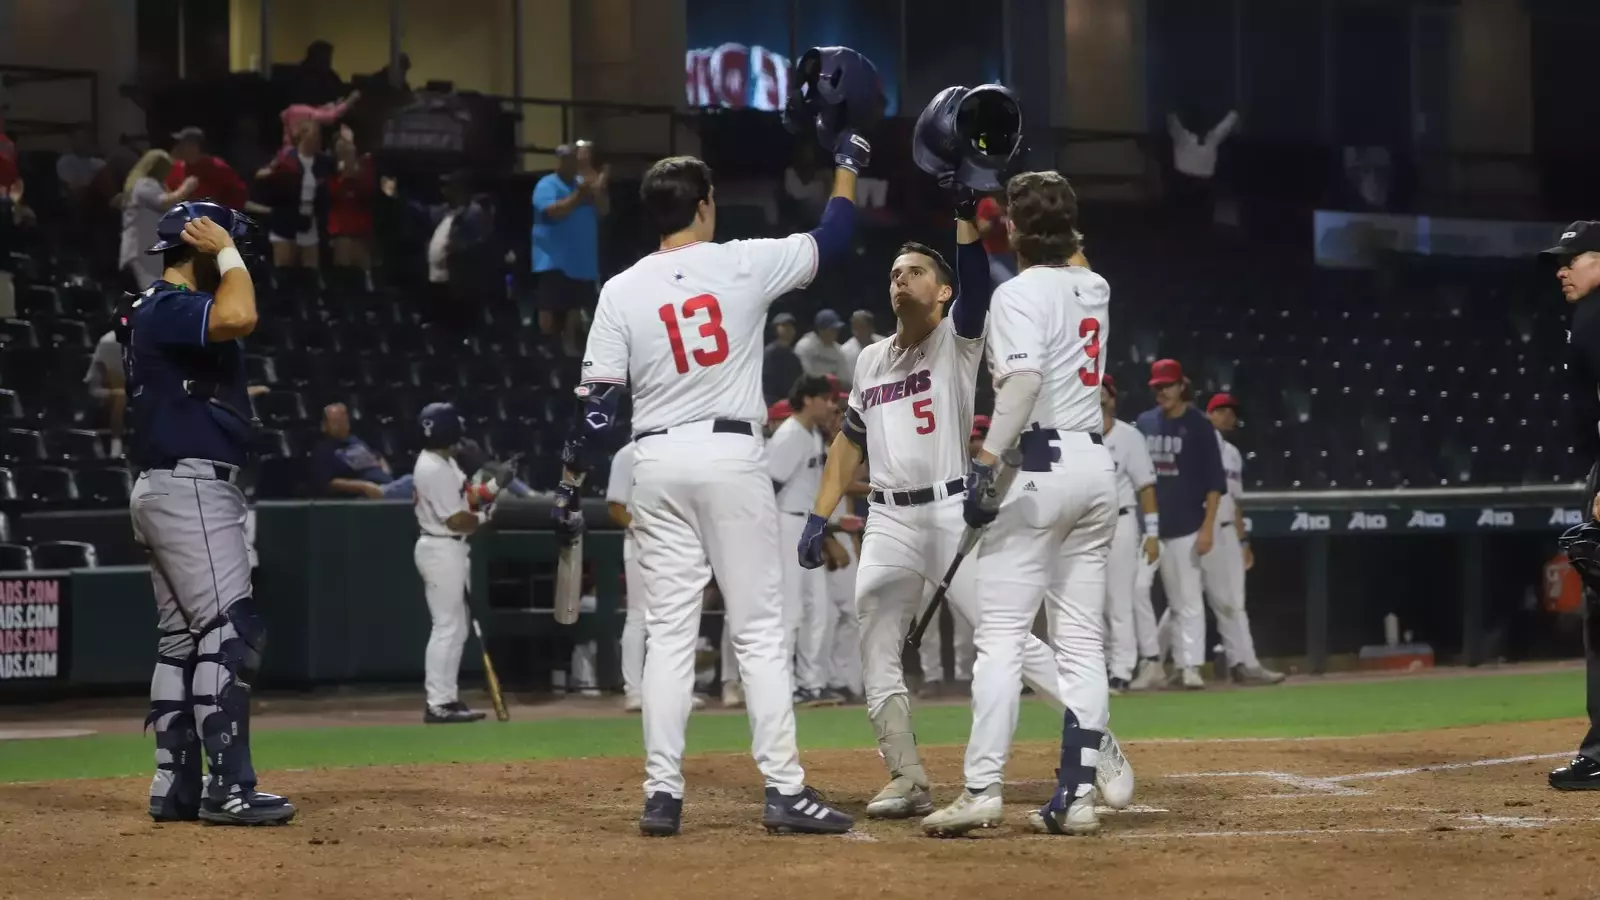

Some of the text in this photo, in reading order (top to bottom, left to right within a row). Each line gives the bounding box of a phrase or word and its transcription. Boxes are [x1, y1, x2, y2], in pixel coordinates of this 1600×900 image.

[658, 293, 729, 375] 13
[1078, 317, 1100, 387] 3
[912, 397, 936, 435] 5
